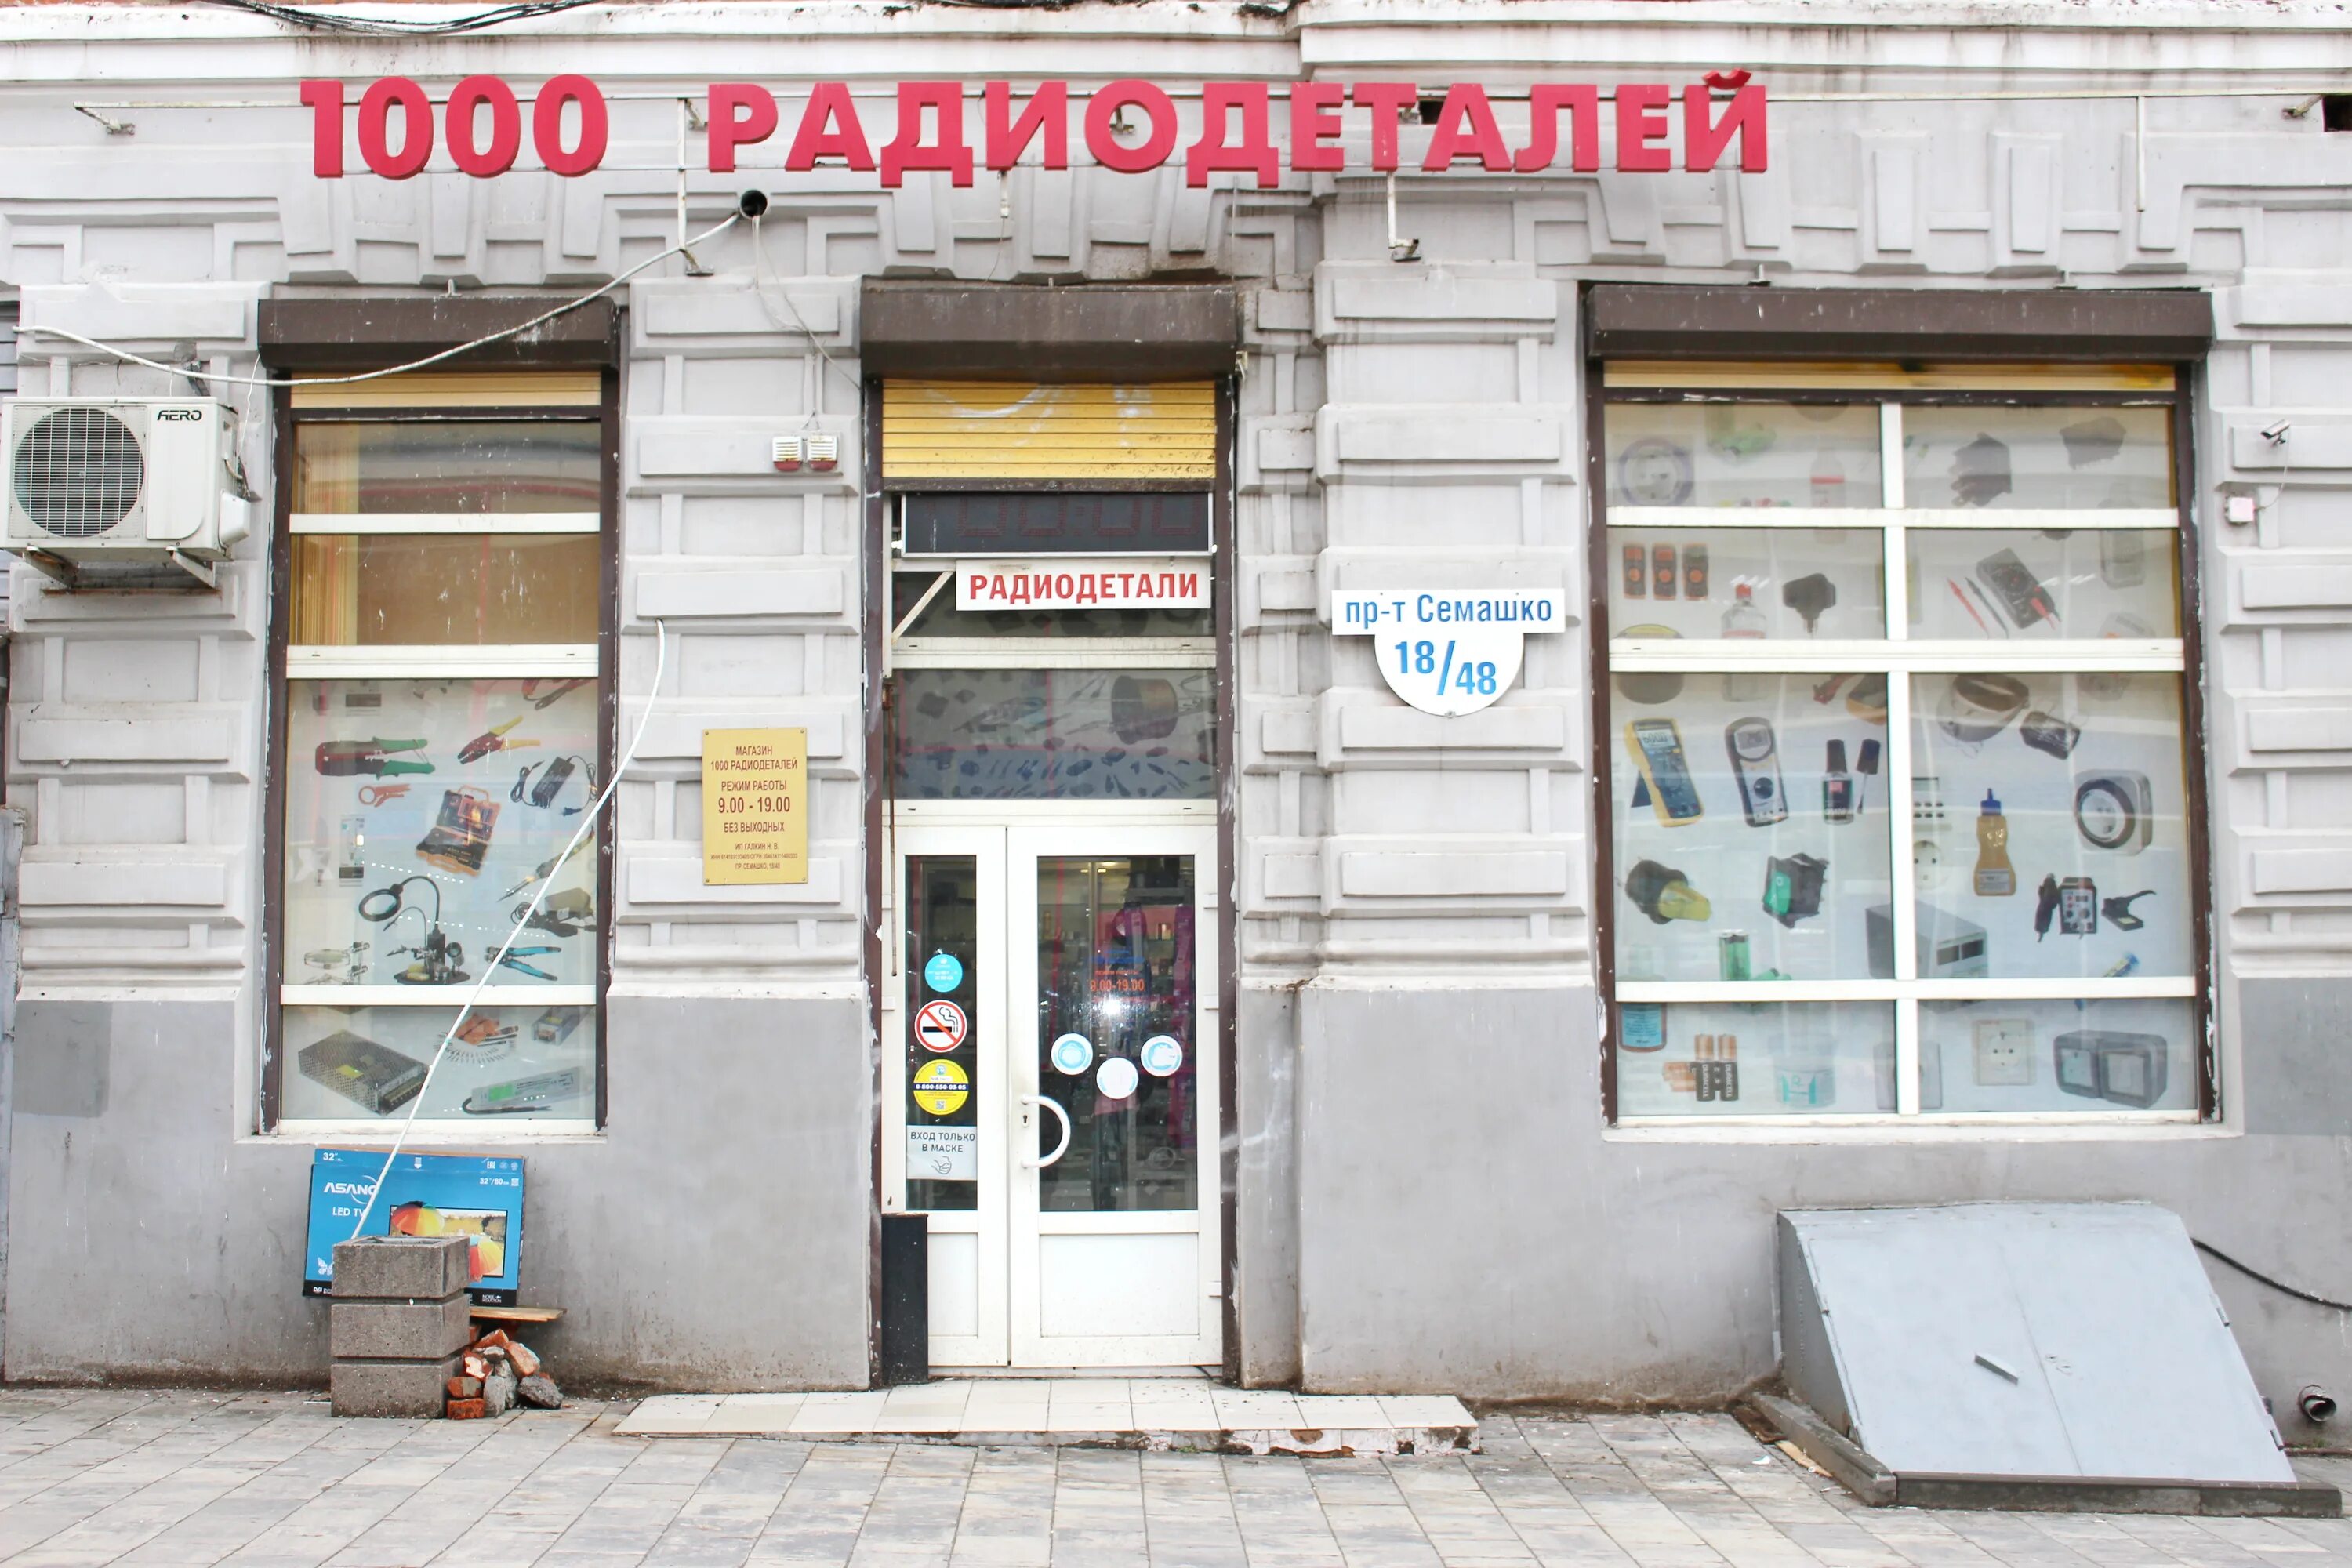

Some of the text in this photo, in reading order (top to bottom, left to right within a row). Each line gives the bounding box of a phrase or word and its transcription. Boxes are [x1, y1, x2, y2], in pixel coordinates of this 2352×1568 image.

[300, 69, 1768, 188] 1000 РАДИОДЕТАЛЕЙ
[157, 410, 202, 421] AERO
[970, 573, 1198, 604] РАДИОДЕТАЛИ
[1345, 594, 1552, 629] пр-т Семашко
[1395, 641, 1497, 695] 18/48
[735, 746, 773, 756] МАГАЗИН
[710, 757, 797, 771] 1000 РАДИОДЕТАЛЕЙ
[721, 780, 787, 791] РЕЖИМ РАБОТЫ
[718, 797, 744, 813] 9.00
[757, 796, 791, 812] 19.00
[724, 822, 785, 833] БЕЗ ВЫХОДНЫХ
[910, 1131, 975, 1142] ВХОД ТОЛЬКО
[931, 1144, 964, 1152] МАСКЕ
[332, 1207, 350, 1216] LED
